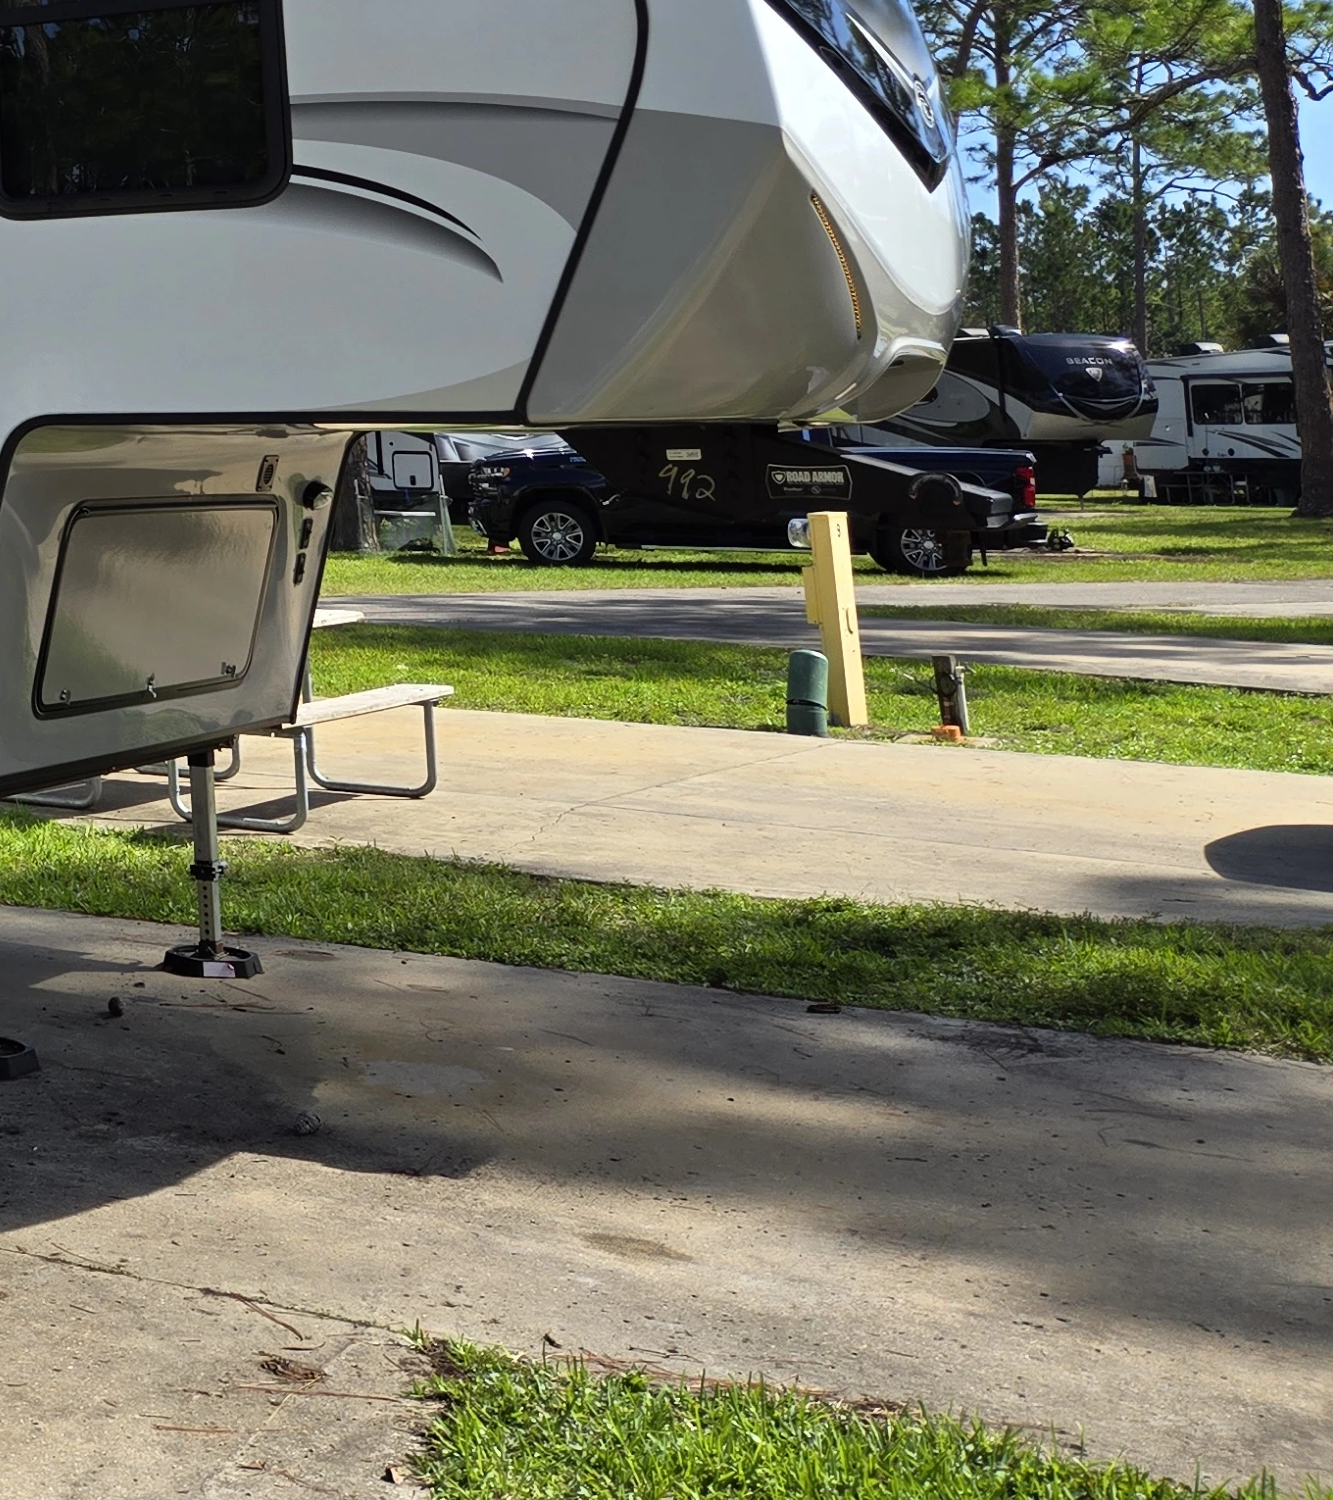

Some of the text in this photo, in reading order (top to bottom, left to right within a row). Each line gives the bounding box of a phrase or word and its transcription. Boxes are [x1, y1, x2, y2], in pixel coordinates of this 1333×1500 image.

[1065, 357, 1113, 365] BEACON
[786, 471, 844, 483] ROAD ARMOR
